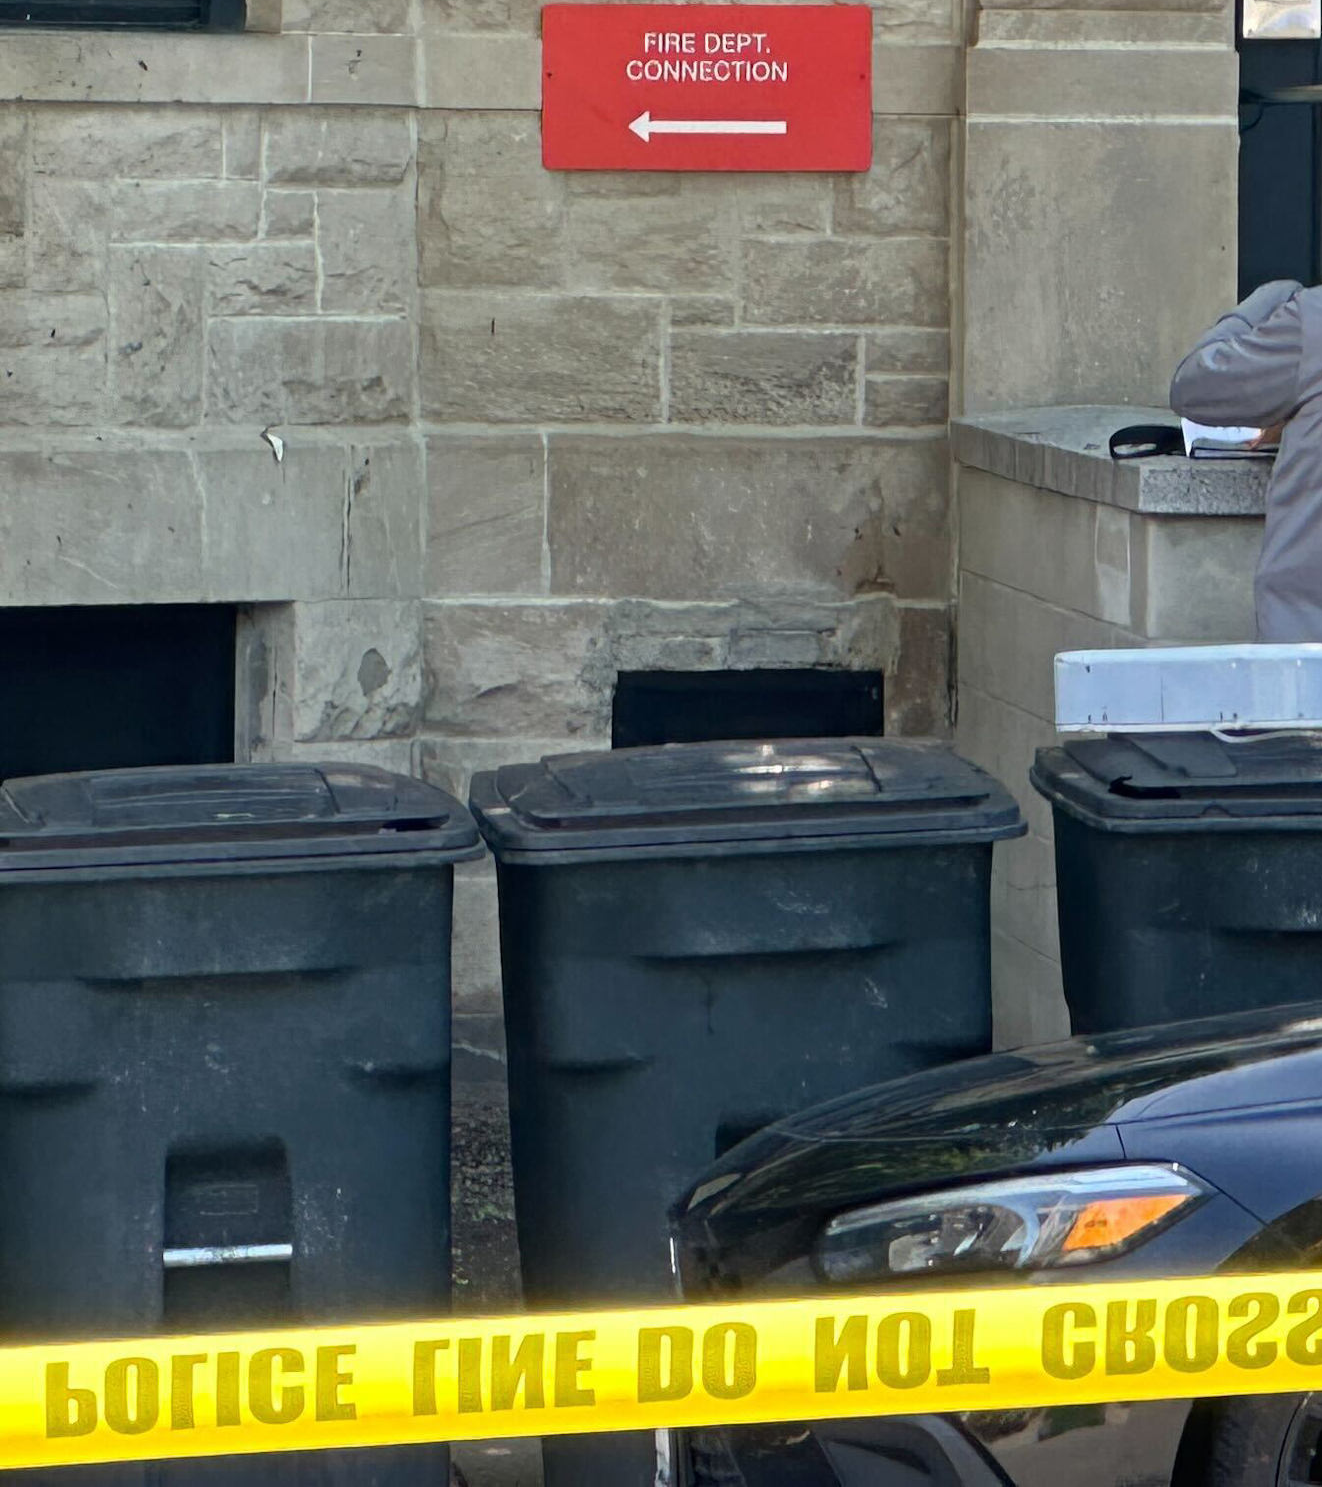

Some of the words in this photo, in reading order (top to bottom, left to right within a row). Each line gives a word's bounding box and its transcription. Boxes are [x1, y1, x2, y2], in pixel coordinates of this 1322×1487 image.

[644, 32, 696, 54] FIRE
[704, 33, 771, 54] DEPT.
[626, 59, 788, 82] CONNECTION
